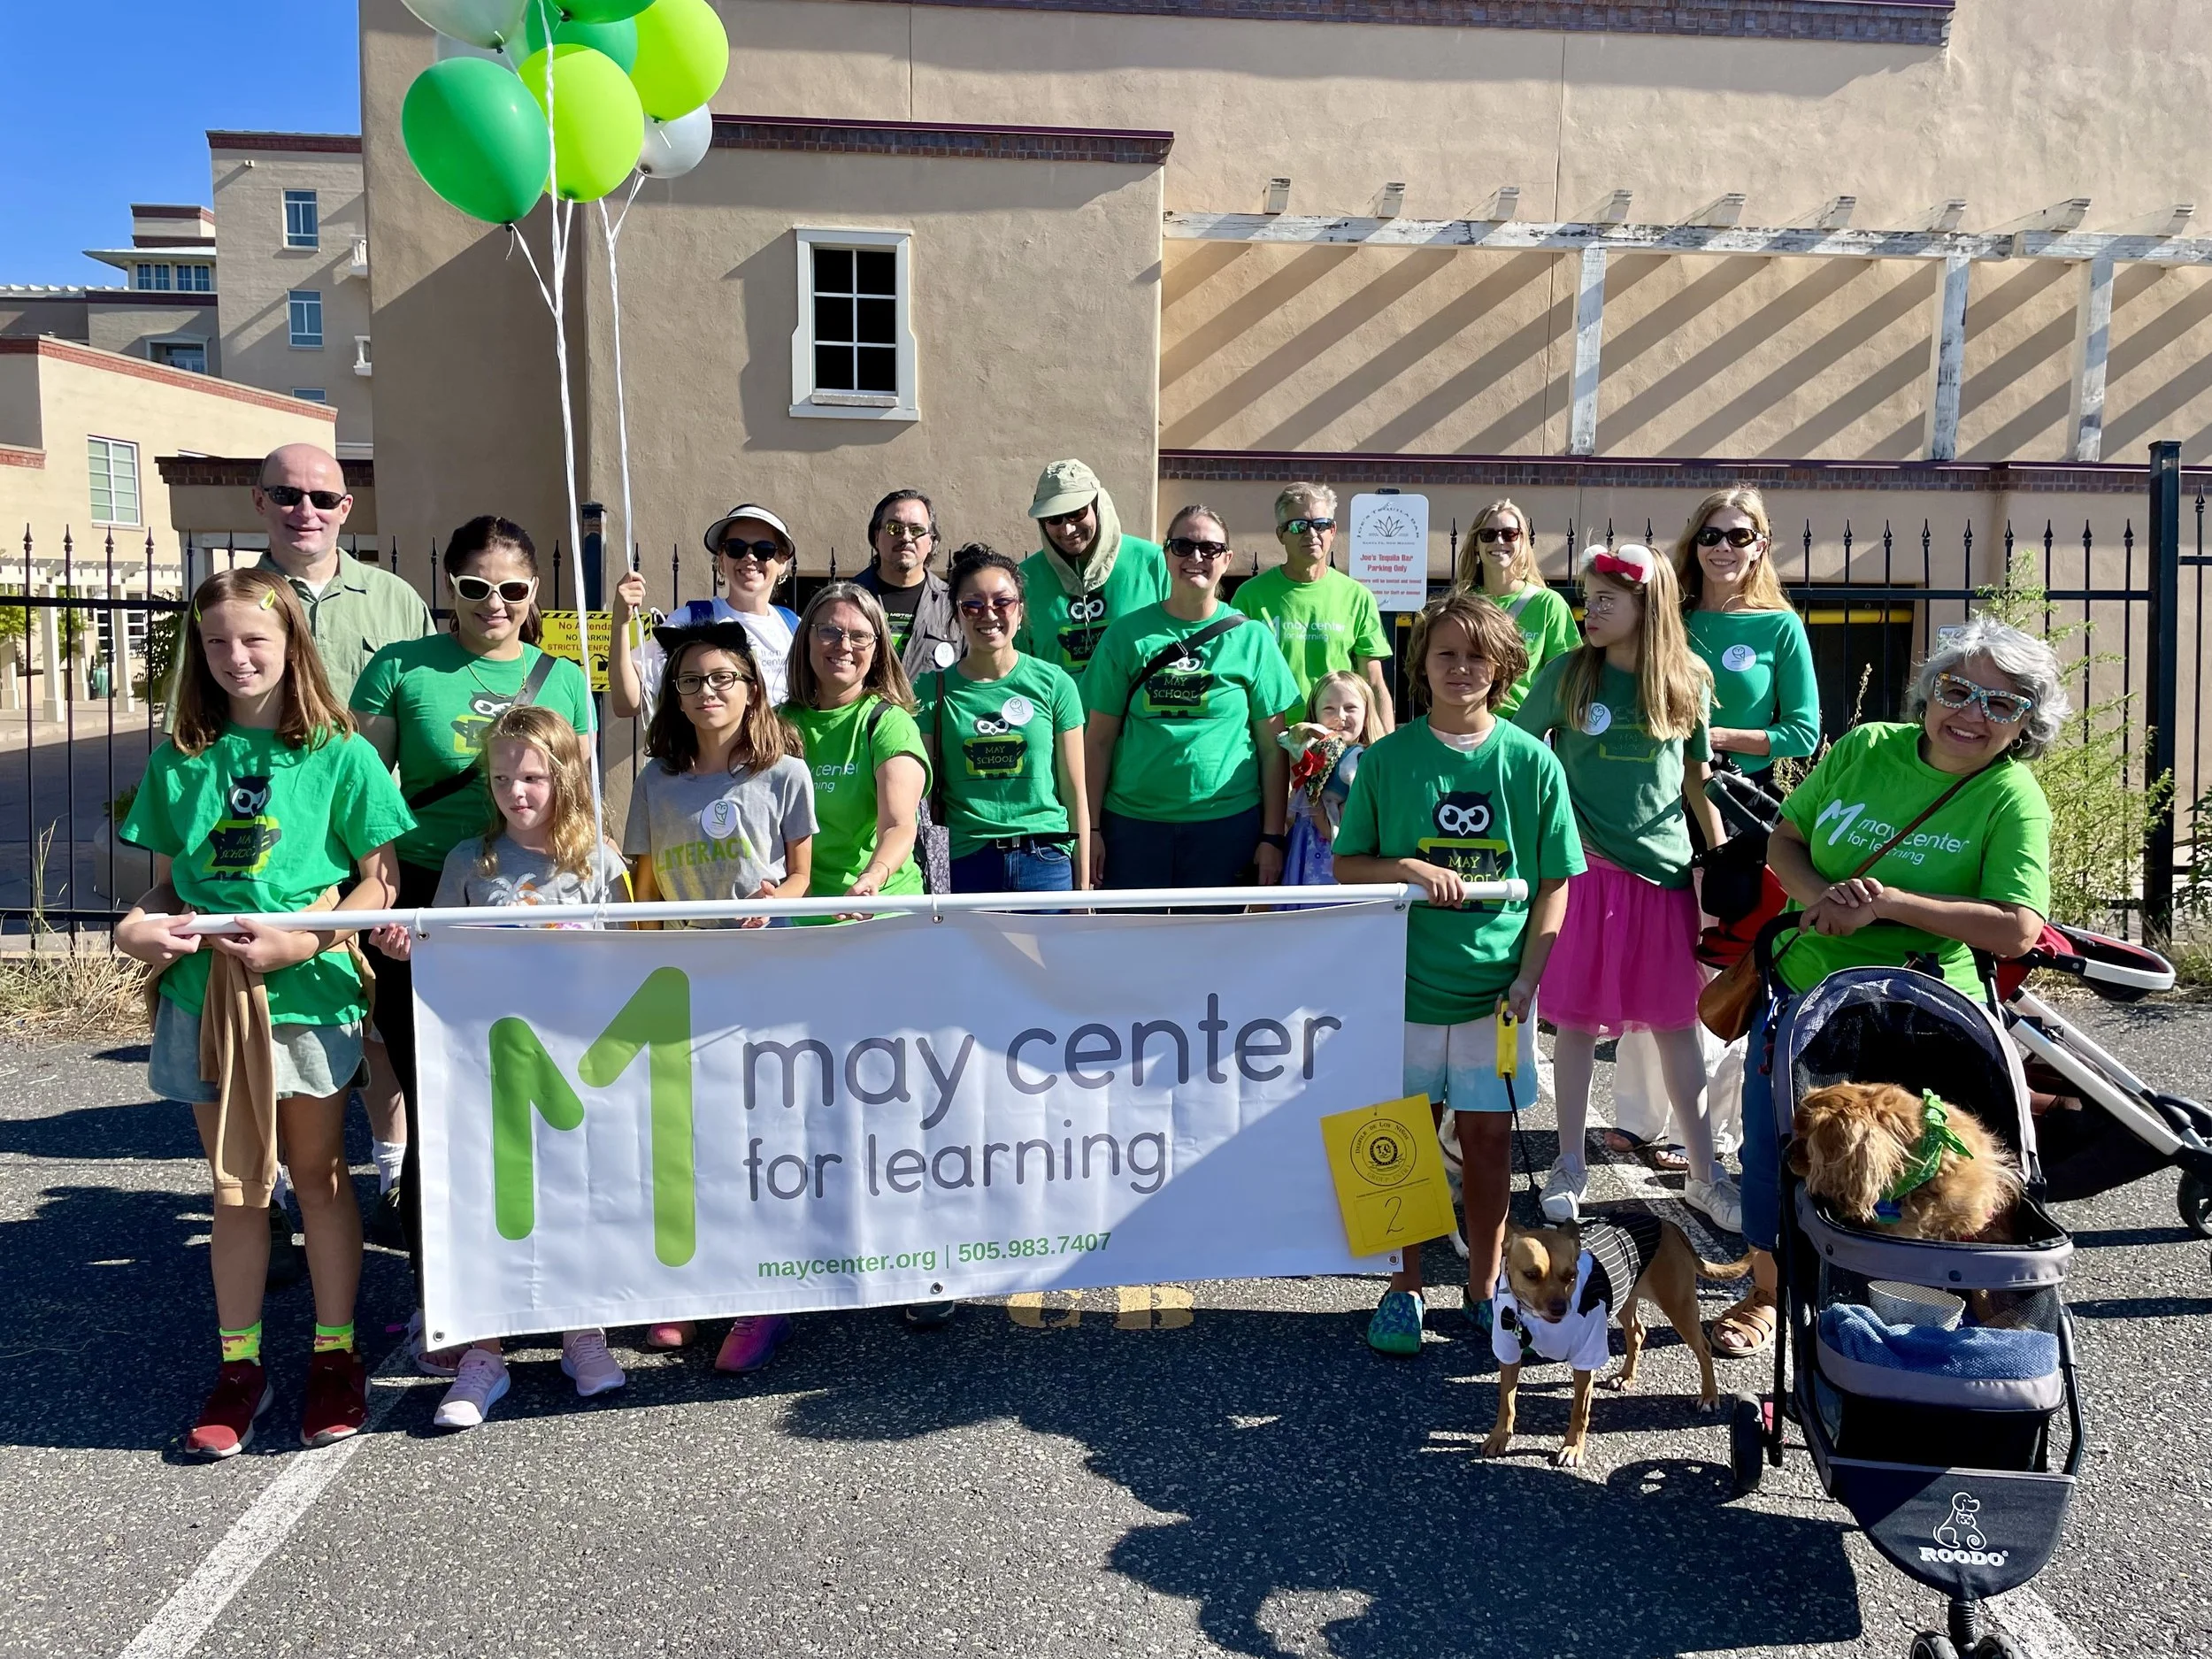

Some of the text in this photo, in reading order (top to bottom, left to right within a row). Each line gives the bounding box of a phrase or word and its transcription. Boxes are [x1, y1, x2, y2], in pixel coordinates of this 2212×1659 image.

[1379, 554, 1400, 563] Tequila
[1367, 564, 1408, 573] Parking Only
[558, 621, 572, 630] No
[1164, 676, 1188, 687] MAY
[1153, 689, 1198, 699] SCHOOL
[977, 755, 1016, 765] SCHOOL
[1847, 831, 1868, 847] for
[1857, 818, 1902, 844] may
[1902, 832, 1970, 853] center
[1448, 856, 1481, 869] MAY
[742, 1033, 975, 1130] may
[1005, 993, 1342, 1094] center
[742, 1118, 1166, 1202] for learning
[1384, 1195, 1405, 1236] 2
[757, 1248, 937, 1280] maycenter.org
[957, 1232, 1112, 1265] 505.983.7407
